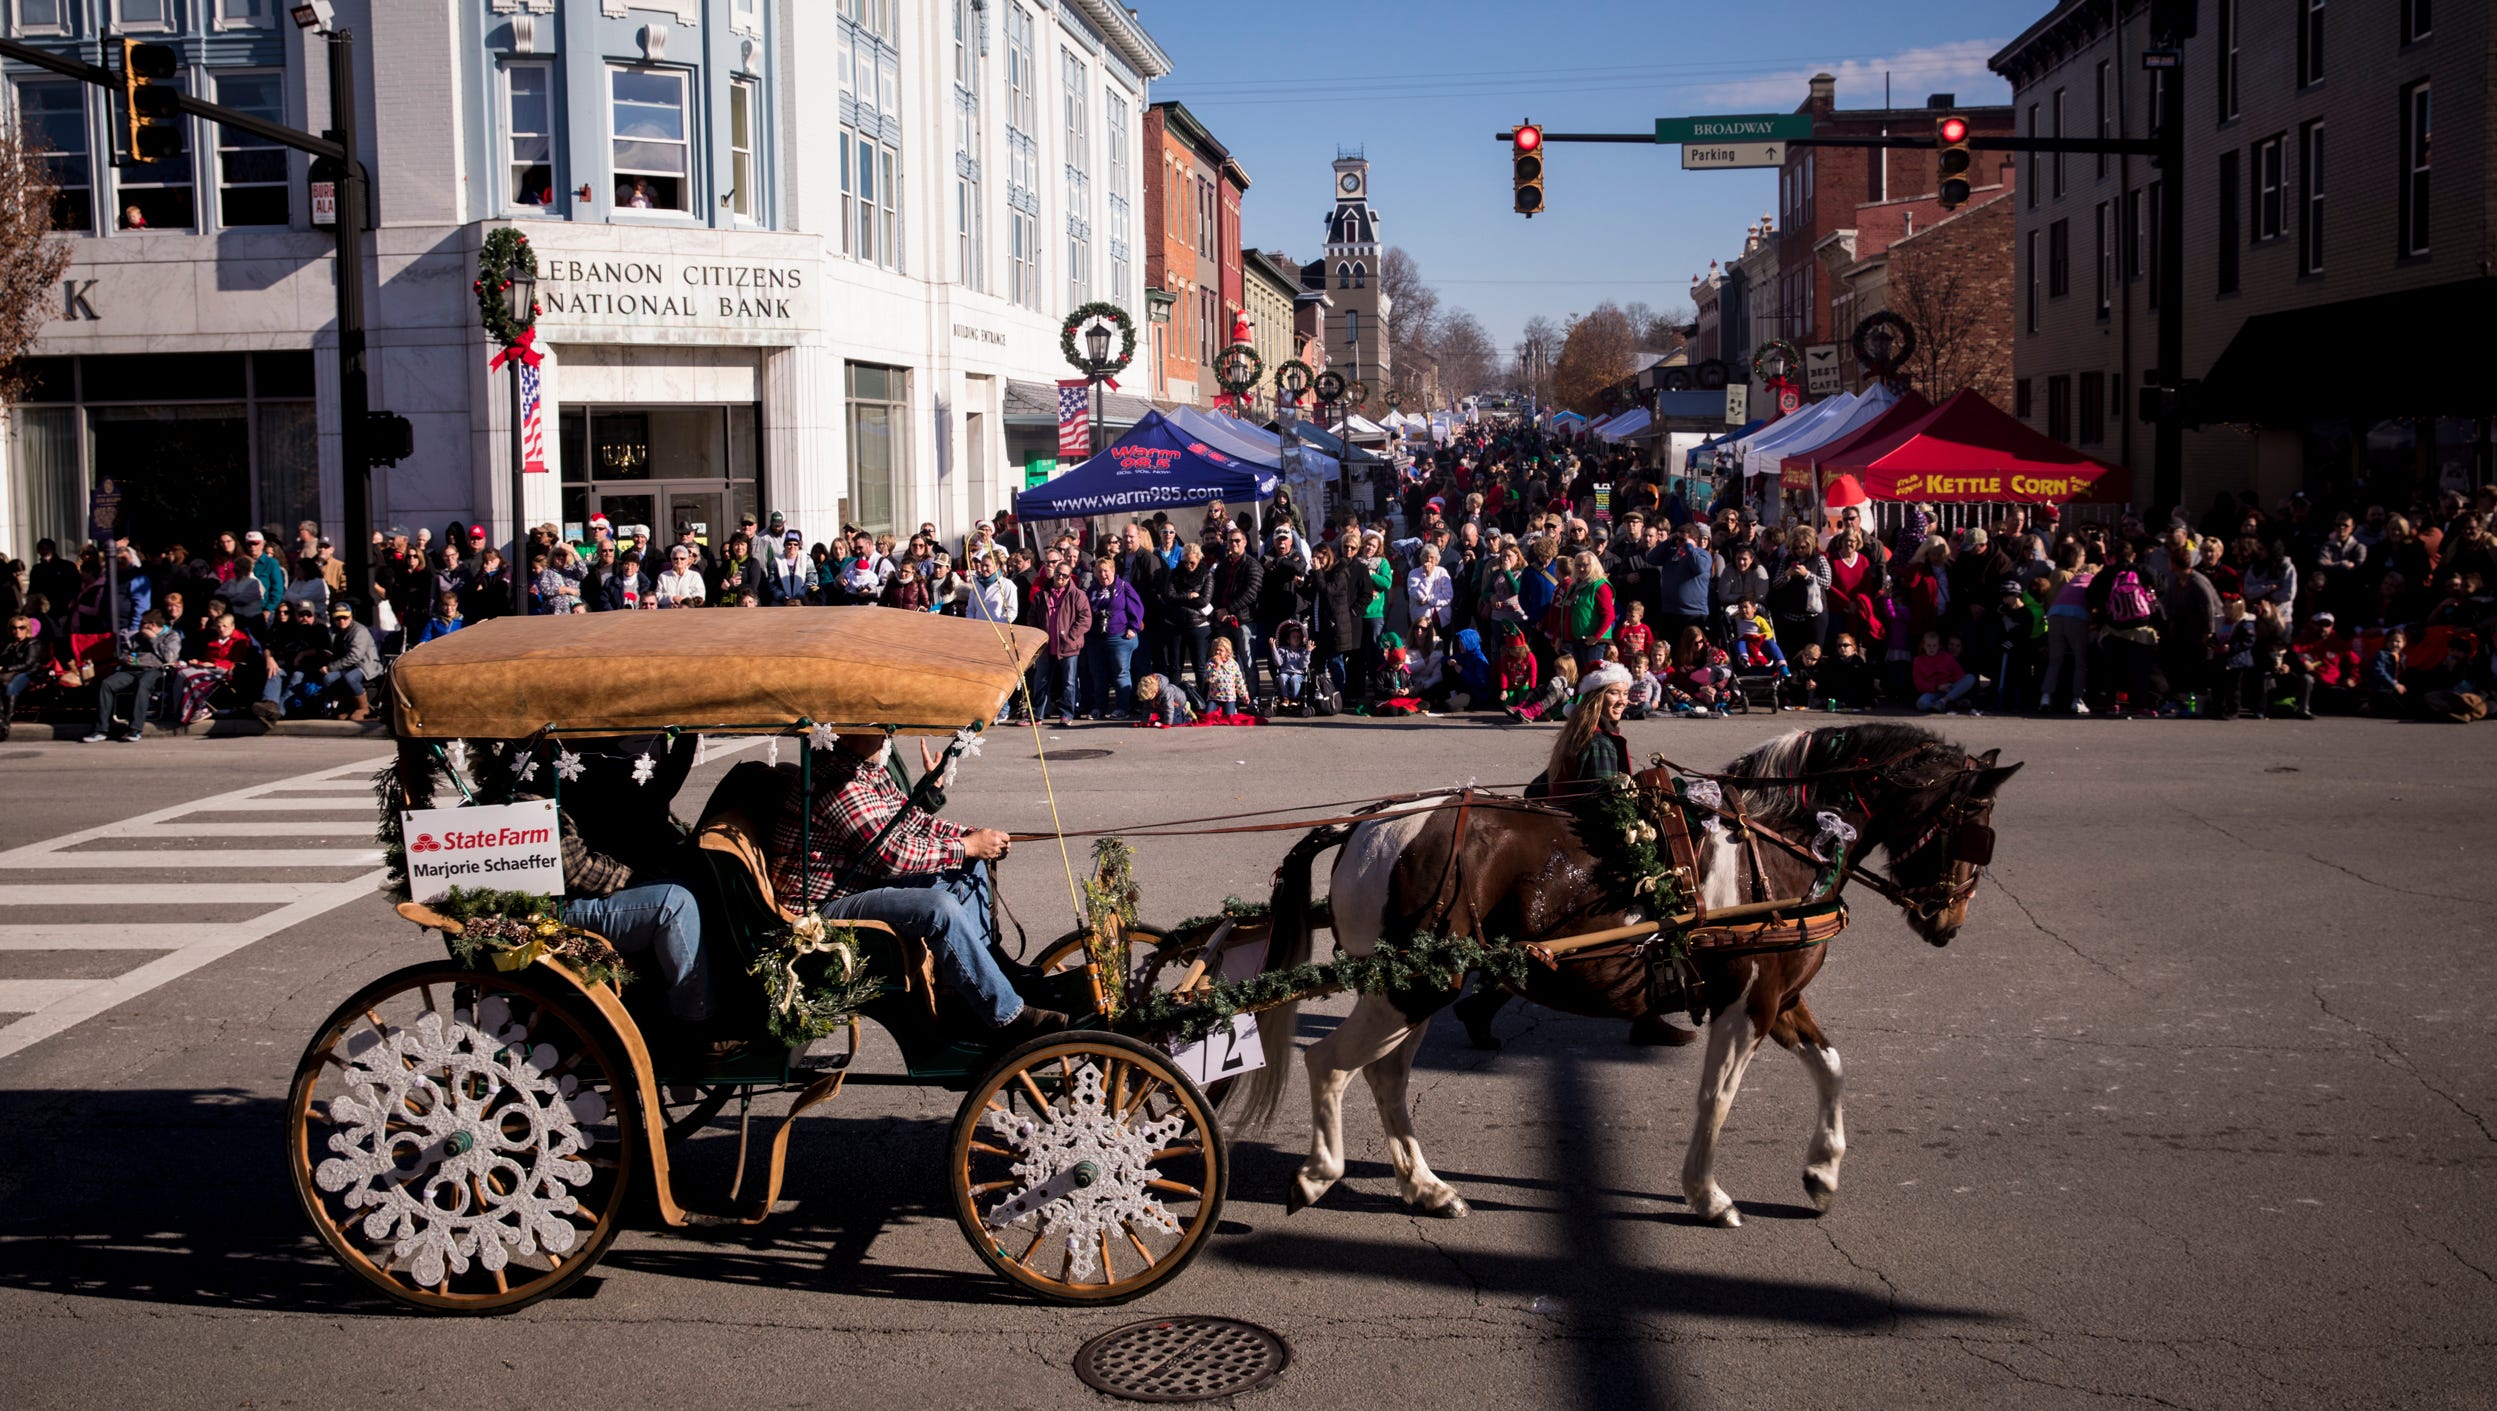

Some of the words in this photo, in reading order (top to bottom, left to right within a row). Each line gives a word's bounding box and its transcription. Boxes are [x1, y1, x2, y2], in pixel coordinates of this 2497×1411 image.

[1694, 122, 1774, 136] BROADWAY
[1691, 149, 1735, 162] Parking
[313, 184, 335, 198] BURG
[316, 199, 335, 213] ALA
[535, 260, 663, 284] LEBANON
[682, 266, 801, 289] CITIZENS
[546, 293, 697, 316] NATIONAL
[719, 297, 791, 319] BANK
[953, 323, 979, 341] BUILDING
[981, 329, 1006, 347] ENTRANCE
[1810, 366, 1838, 377] BEST
[1111, 445, 1181, 460] Warm
[1120, 457, 1171, 470] 98.5
[1926, 475, 2001, 494] KETTLE
[2011, 475, 2068, 496] CORN
[1051, 485, 1225, 512] www.warm985.com
[413, 860, 480, 879] Marjorie
[484, 855, 557, 873] Schaeffer
